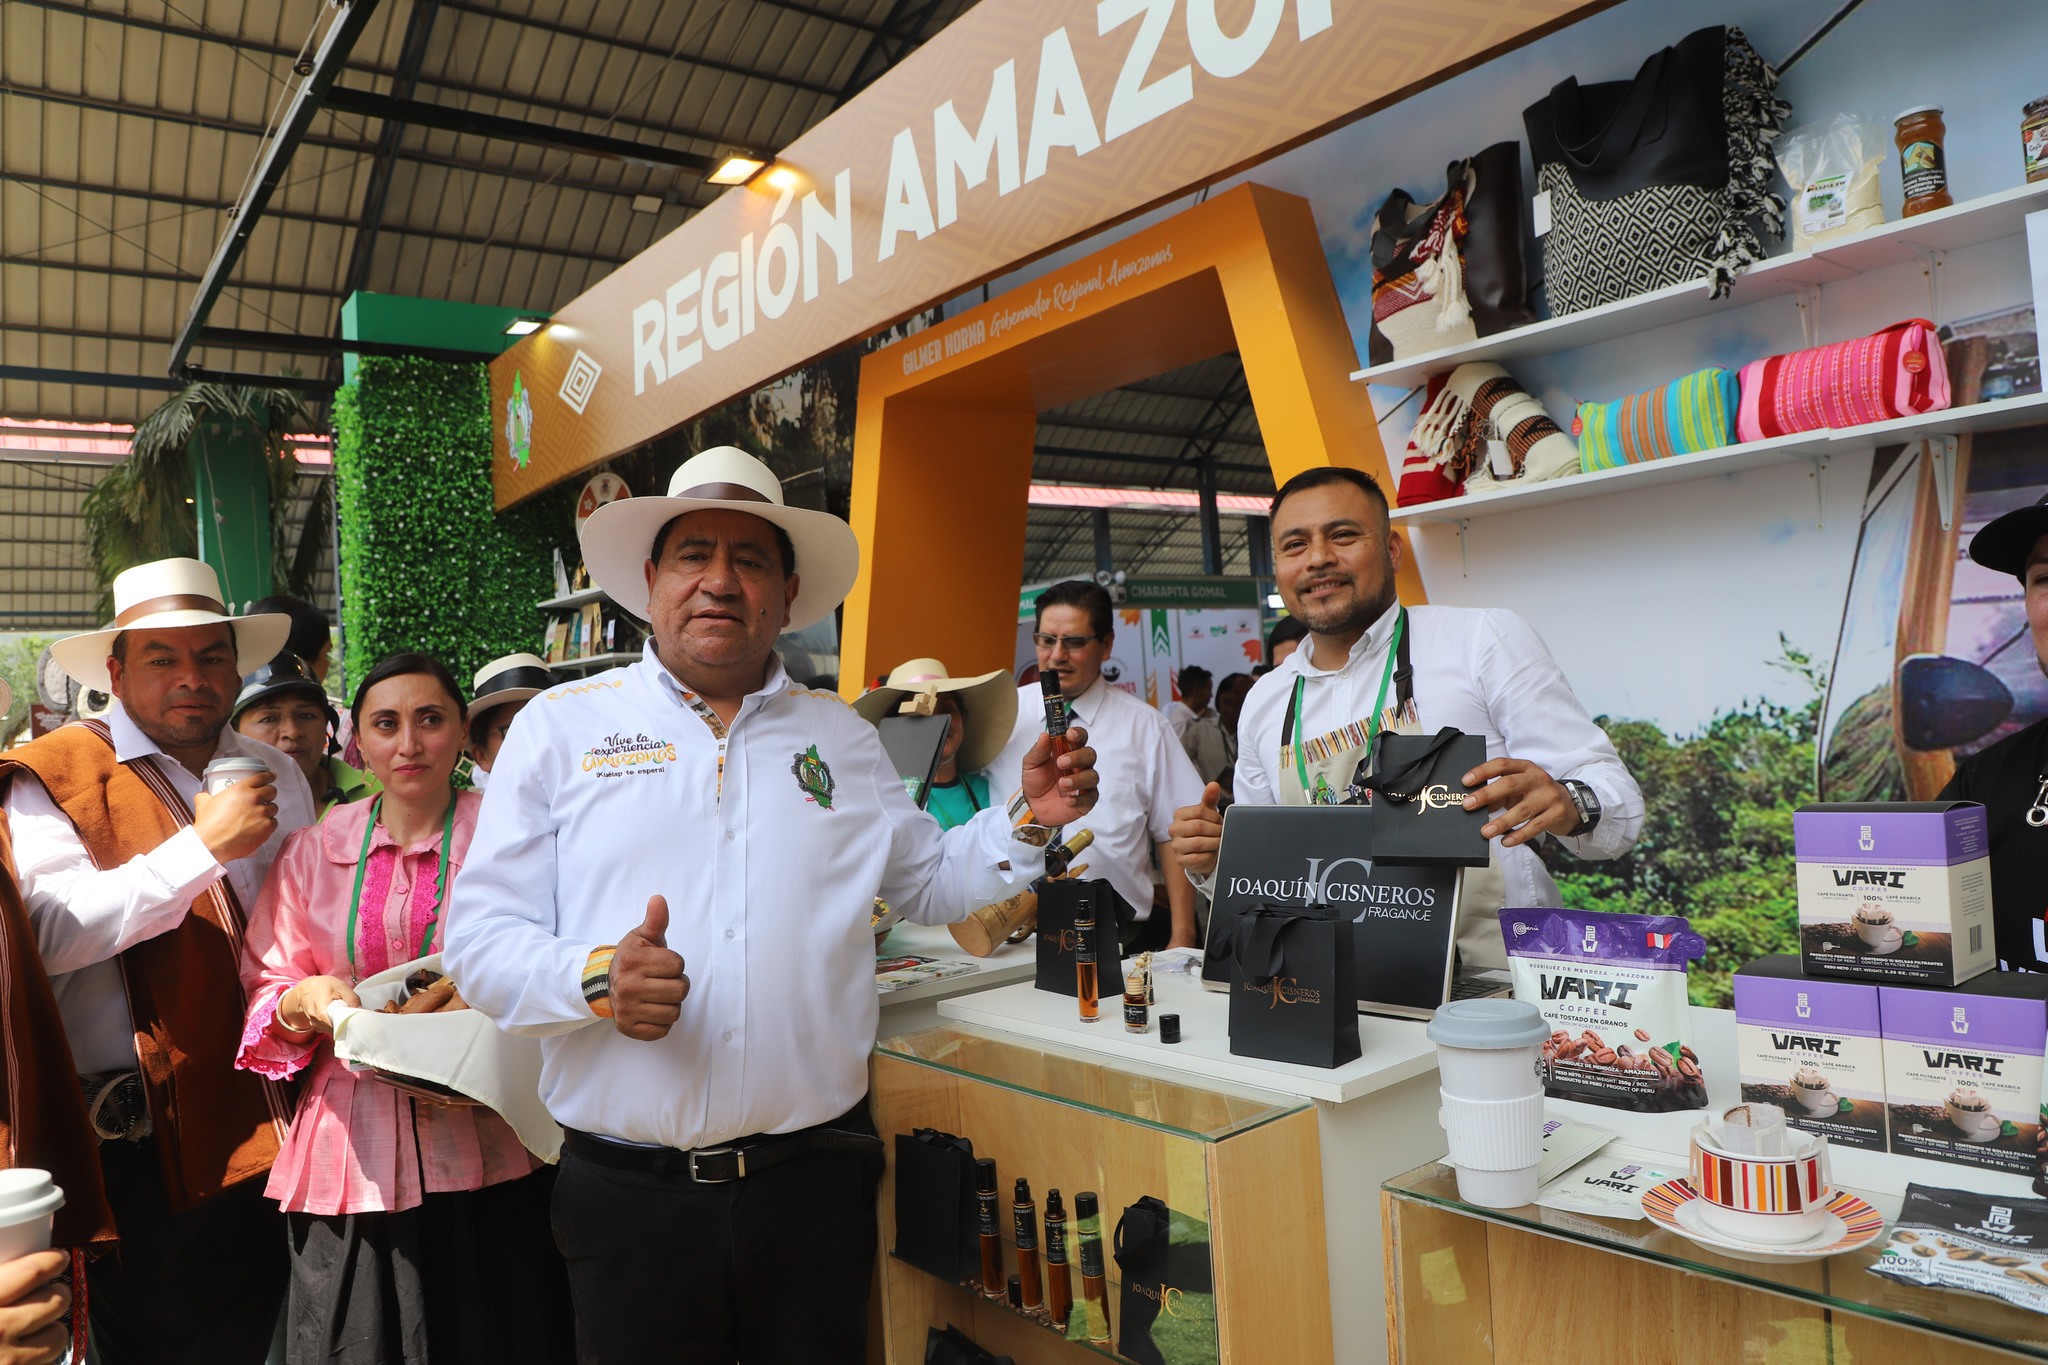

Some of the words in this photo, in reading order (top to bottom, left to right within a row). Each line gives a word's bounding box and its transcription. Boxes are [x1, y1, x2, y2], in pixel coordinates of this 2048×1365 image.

[633, 167, 853, 397] REGIÓN
[877, 0, 1333, 263] AMAZO
[903, 338, 942, 376] GILMER
[944, 320, 986, 358] HORNA
[990, 289, 1052, 338] Gobernador
[1053, 265, 1104, 312] Regional
[1106, 244, 1173, 286] Amazonas
[1130, 586, 1189, 597] CHARAPITA
[1191, 585, 1226, 597] GOMAL
[604, 732, 633, 746] Vive
[636, 733, 649, 742] la
[594, 740, 662, 758] experiencia
[1833, 870, 1906, 889] WARI
[1228, 876, 1318, 900] JOAQUÍN
[1326, 882, 1435, 906] CISNEROS
[1368, 906, 1431, 922] FRAGANCE
[1282, 986, 1320, 998] CISNEROS
[1540, 974, 1638, 1010] WARI
[1560, 1004, 1608, 1016] COFFEE
[1560, 1014, 1588, 1023] TOSTADO
[1600, 1019, 1628, 1028] GRANOS
[1771, 1034, 1841, 1057] WARI
[1790, 1051, 1823, 1059] COFFEE
[1923, 1050, 2004, 1076] WARI
[1593, 1064, 1619, 1073] MENDOZA
[1945, 1070, 1983, 1078] COFFEE
[1606, 1084, 1631, 1092] PRODUCT
[1584, 1177, 1639, 1193] WARI
[1954, 1223, 2033, 1244] WARI
[1882, 1256, 1922, 1267] 100%
